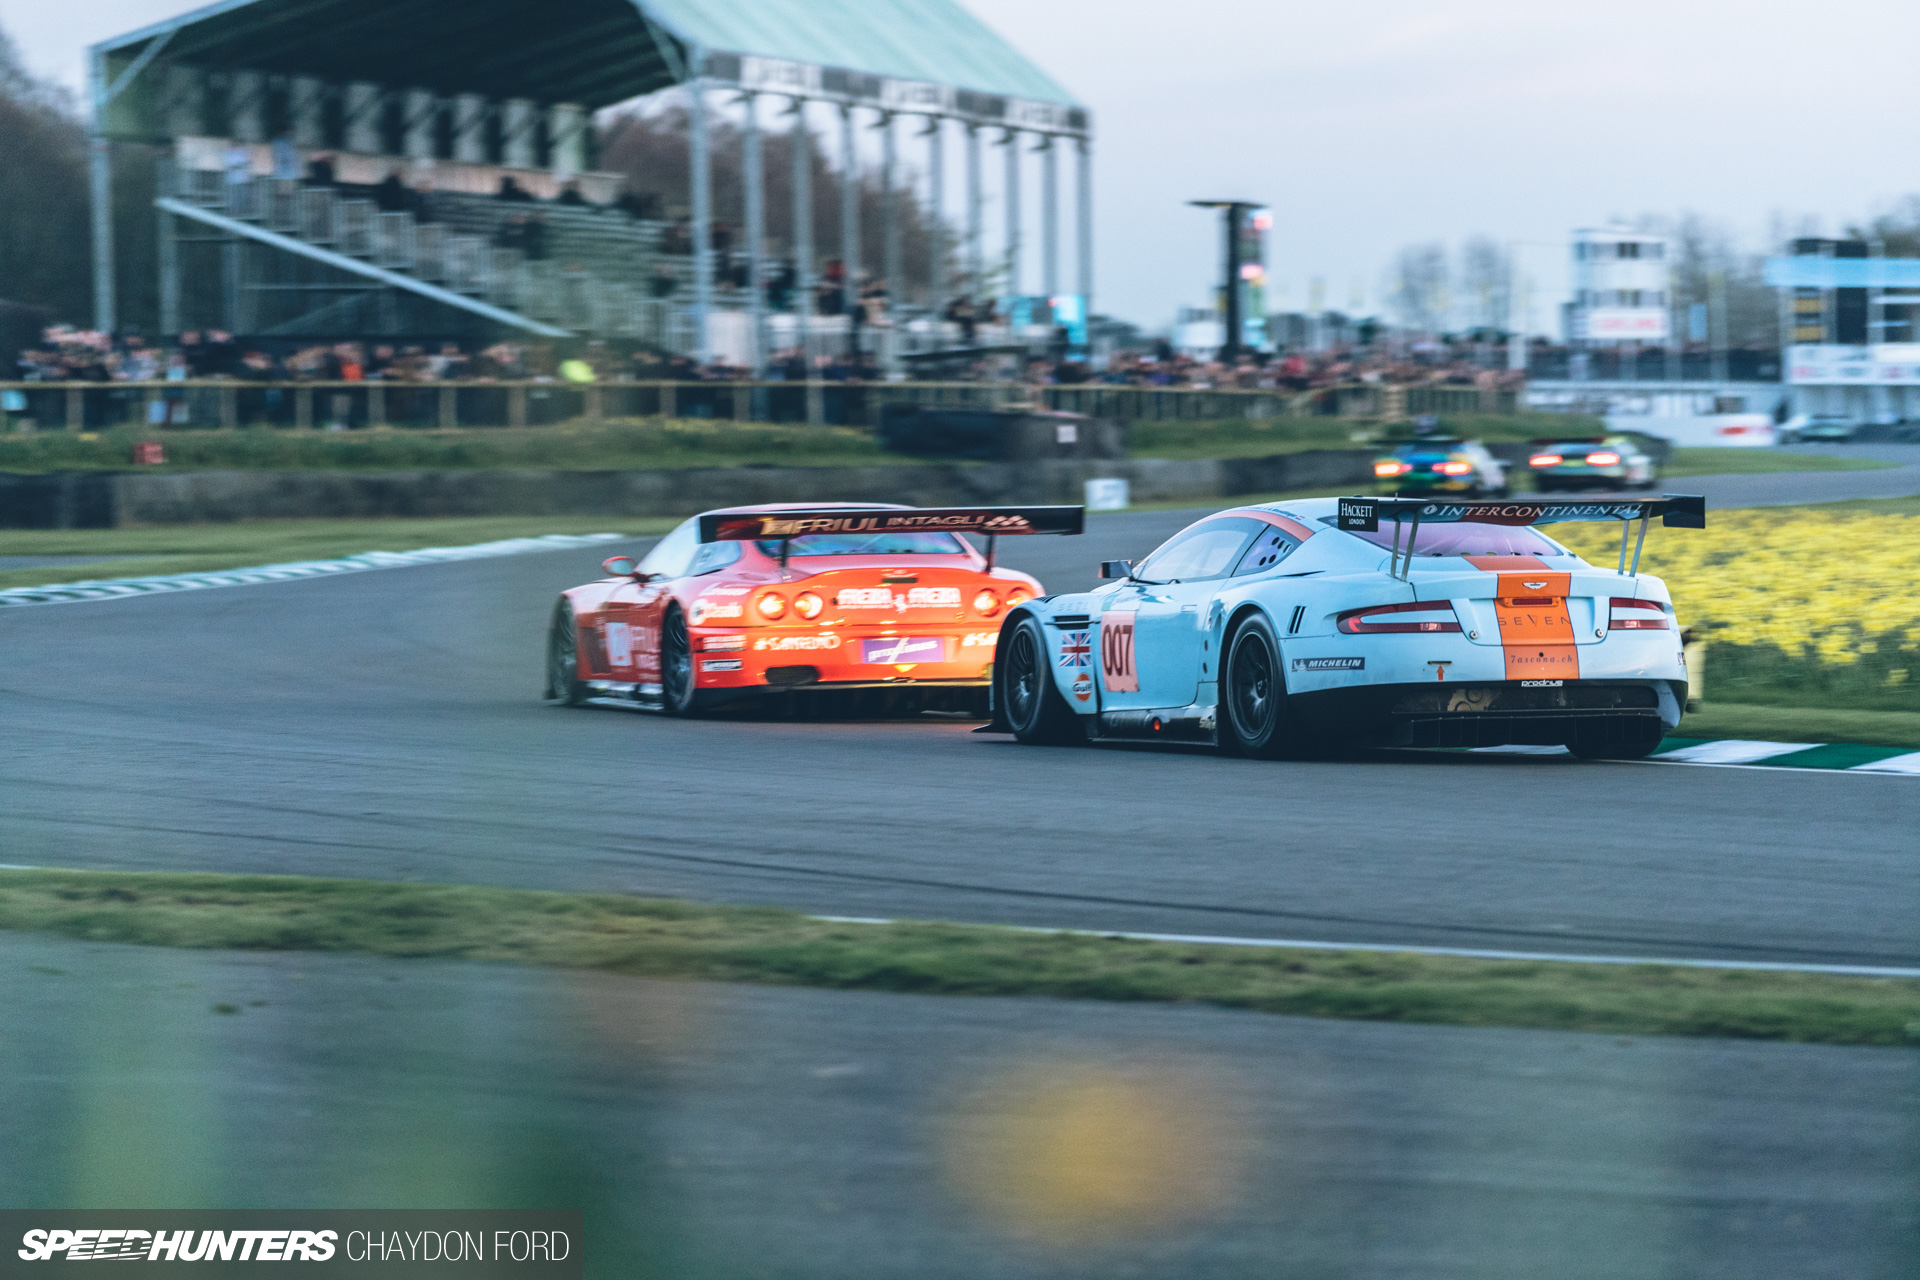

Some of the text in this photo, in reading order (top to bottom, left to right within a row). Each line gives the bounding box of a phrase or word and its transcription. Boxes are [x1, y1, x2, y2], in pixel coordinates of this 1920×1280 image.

[1341, 503, 1373, 517] HACKETT
[1102, 624, 1134, 676] 007
[1308, 659, 1362, 667] MICHELIN
[1510, 655, 1573, 663] 7ascona.ch
[1521, 679, 1563, 687] prodrive
